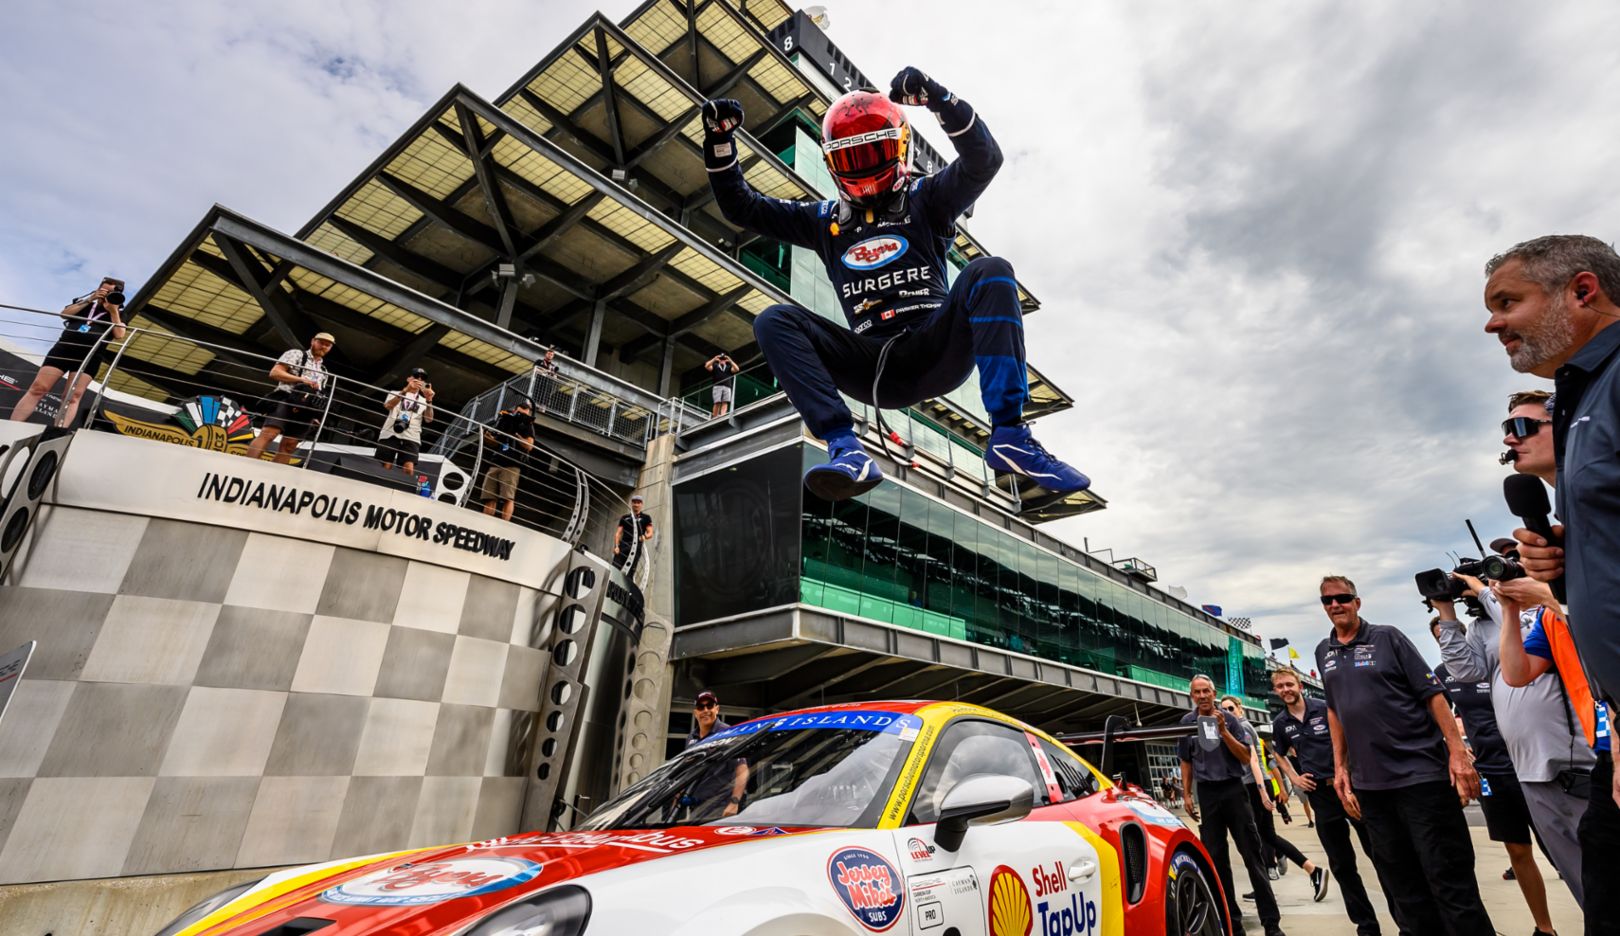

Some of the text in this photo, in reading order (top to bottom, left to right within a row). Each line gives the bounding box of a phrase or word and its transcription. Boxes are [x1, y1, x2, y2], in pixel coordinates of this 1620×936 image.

[784, 36, 794, 51] 8
[829, 62, 852, 92] 1 2
[825, 129, 898, 150] PORSCHE
[842, 266, 931, 298] SURGERE
[124, 425, 195, 448] INDIANAPOLIS
[197, 472, 516, 561] INDIANAPOLIS MOTOR SPEEDWAY
[789, 714, 910, 730] ISLANDS
[911, 850, 931, 860] LEVEL
[836, 861, 893, 888] Jersey
[1032, 860, 1068, 898] Shell
[868, 910, 888, 923] SUBS
[925, 909, 937, 921] PRO
[1037, 891, 1097, 936] TapUp
